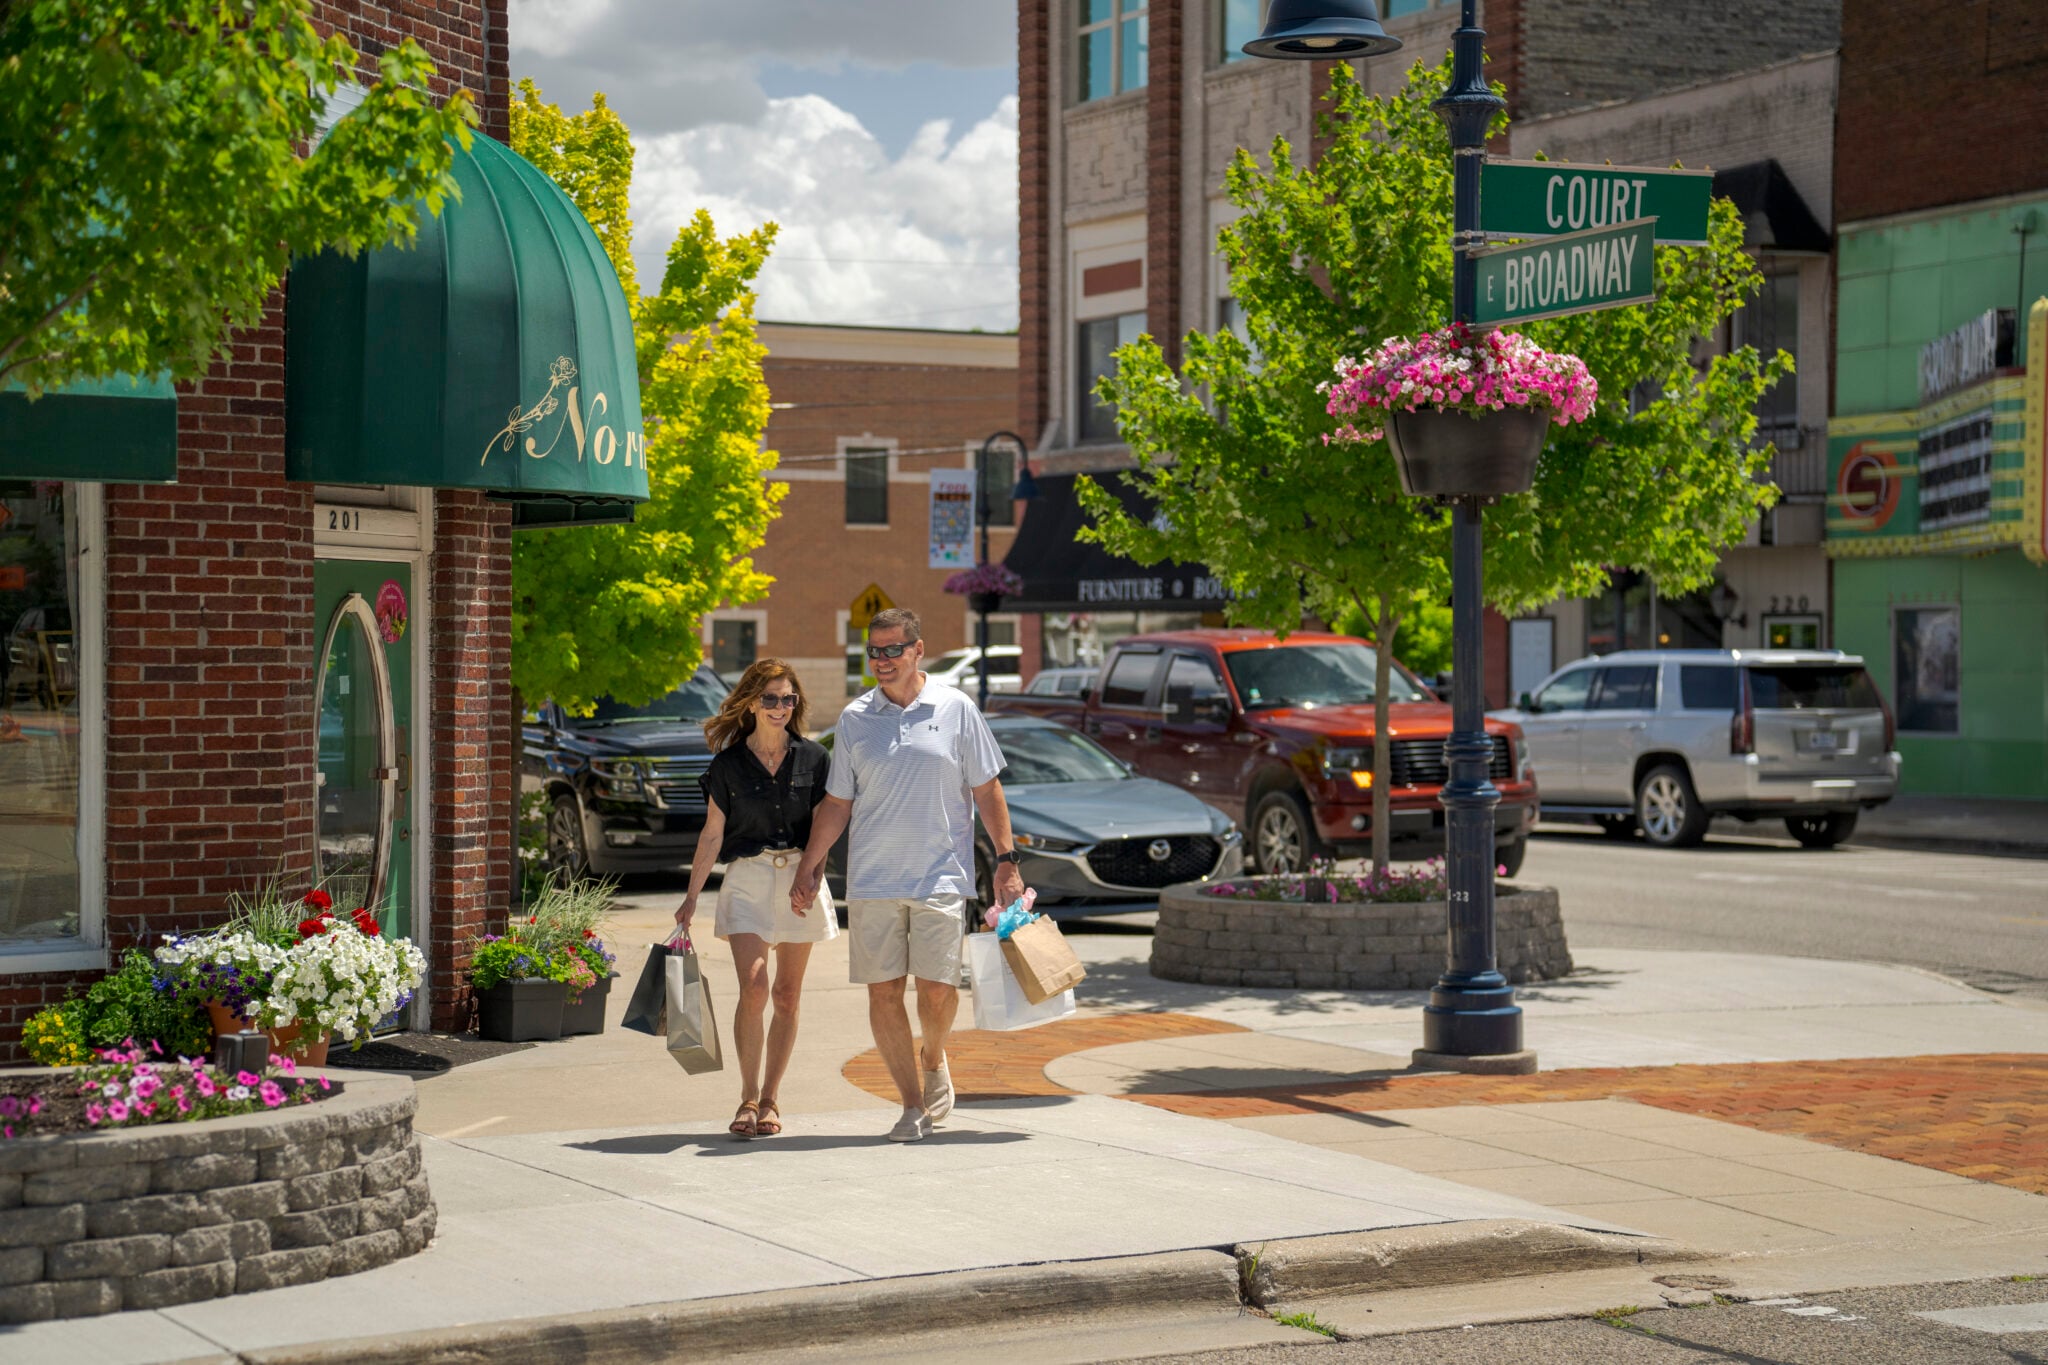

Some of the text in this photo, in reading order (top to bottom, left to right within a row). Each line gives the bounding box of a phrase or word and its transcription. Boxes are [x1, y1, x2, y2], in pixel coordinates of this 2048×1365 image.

[1546, 175, 1647, 229] COURT
[1487, 235, 1638, 312] E BROADWAY
[329, 510, 359, 531] 201
[1078, 577, 1163, 602] FURNITURE
[1770, 594, 1809, 614] 220
